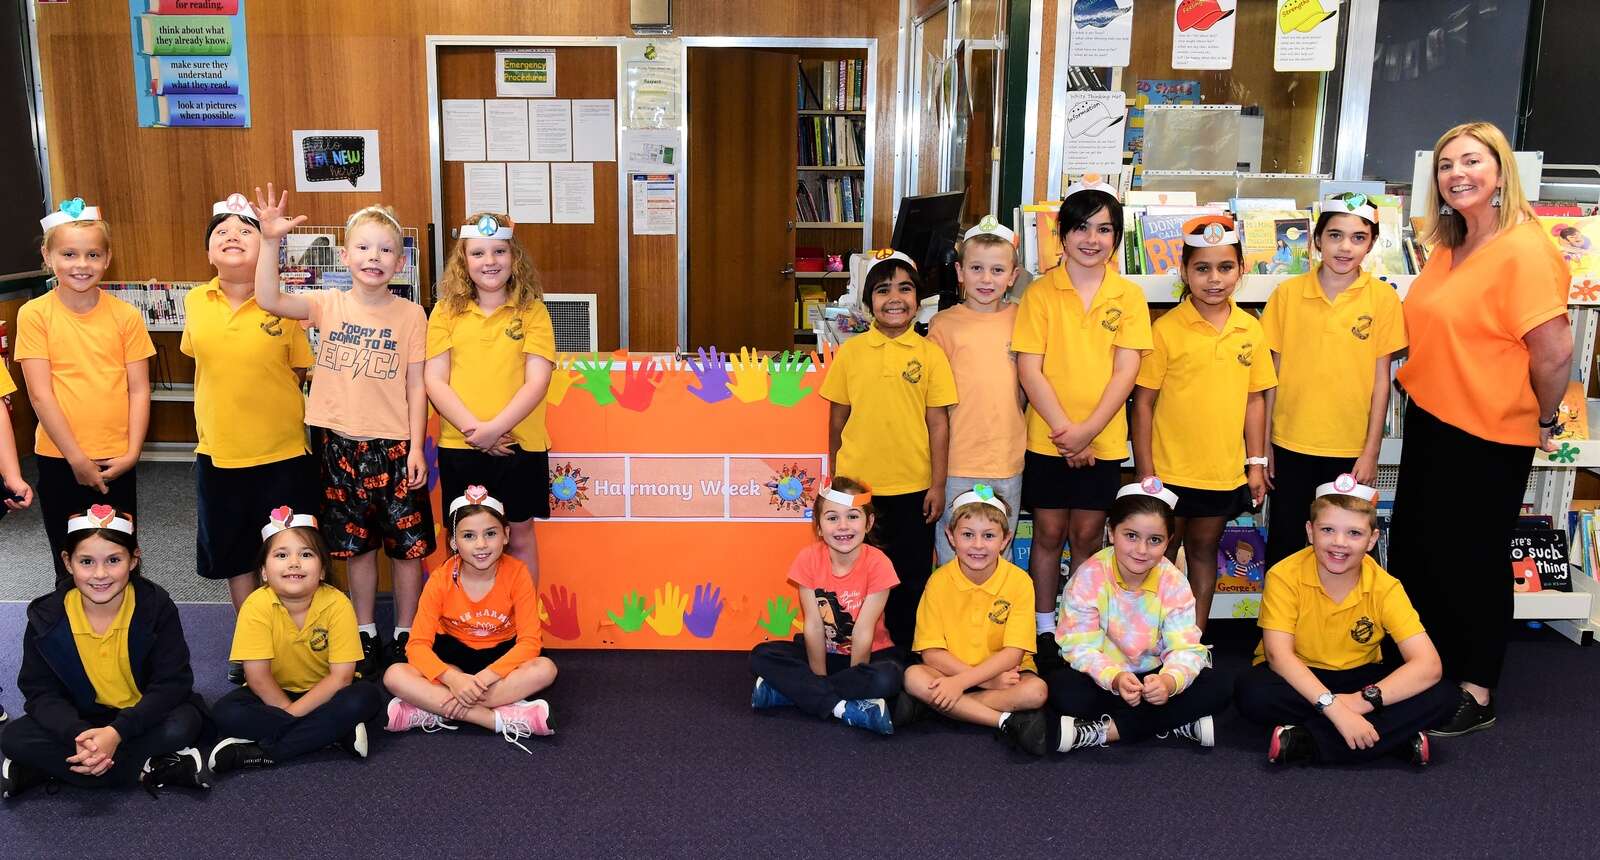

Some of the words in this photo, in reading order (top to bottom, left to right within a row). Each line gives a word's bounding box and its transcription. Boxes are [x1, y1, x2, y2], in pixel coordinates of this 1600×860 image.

[175, 0, 187, 8] for
[190, 0, 224, 10] reading.
[159, 26, 180, 34] think
[181, 26, 203, 34] about
[205, 26, 224, 34] what
[156, 36, 173, 45] they
[174, 36, 204, 45] already
[205, 36, 229, 44] know.
[170, 60, 192, 69] make
[212, 60, 229, 70] they
[504, 59, 548, 70] Emergency
[178, 71, 222, 79] understand
[504, 71, 548, 81] Procedures
[171, 80, 190, 89] what
[191, 80, 209, 91] they
[210, 81, 231, 89] read.
[177, 101, 195, 109] look
[205, 101, 237, 111] pictures
[179, 112, 201, 120] when
[202, 112, 236, 122] possible.
[331, 149, 361, 165] NEW
[341, 321, 377, 338] TODAY
[379, 327, 392, 339] IS
[329, 330, 361, 345] GOING
[365, 338, 380, 350] TO
[384, 340, 398, 351] BE
[1511, 538, 1532, 547] ere's
[1529, 543, 1564, 560] such
[1536, 560, 1568, 580] thing
[1217, 582, 1257, 592] George's
